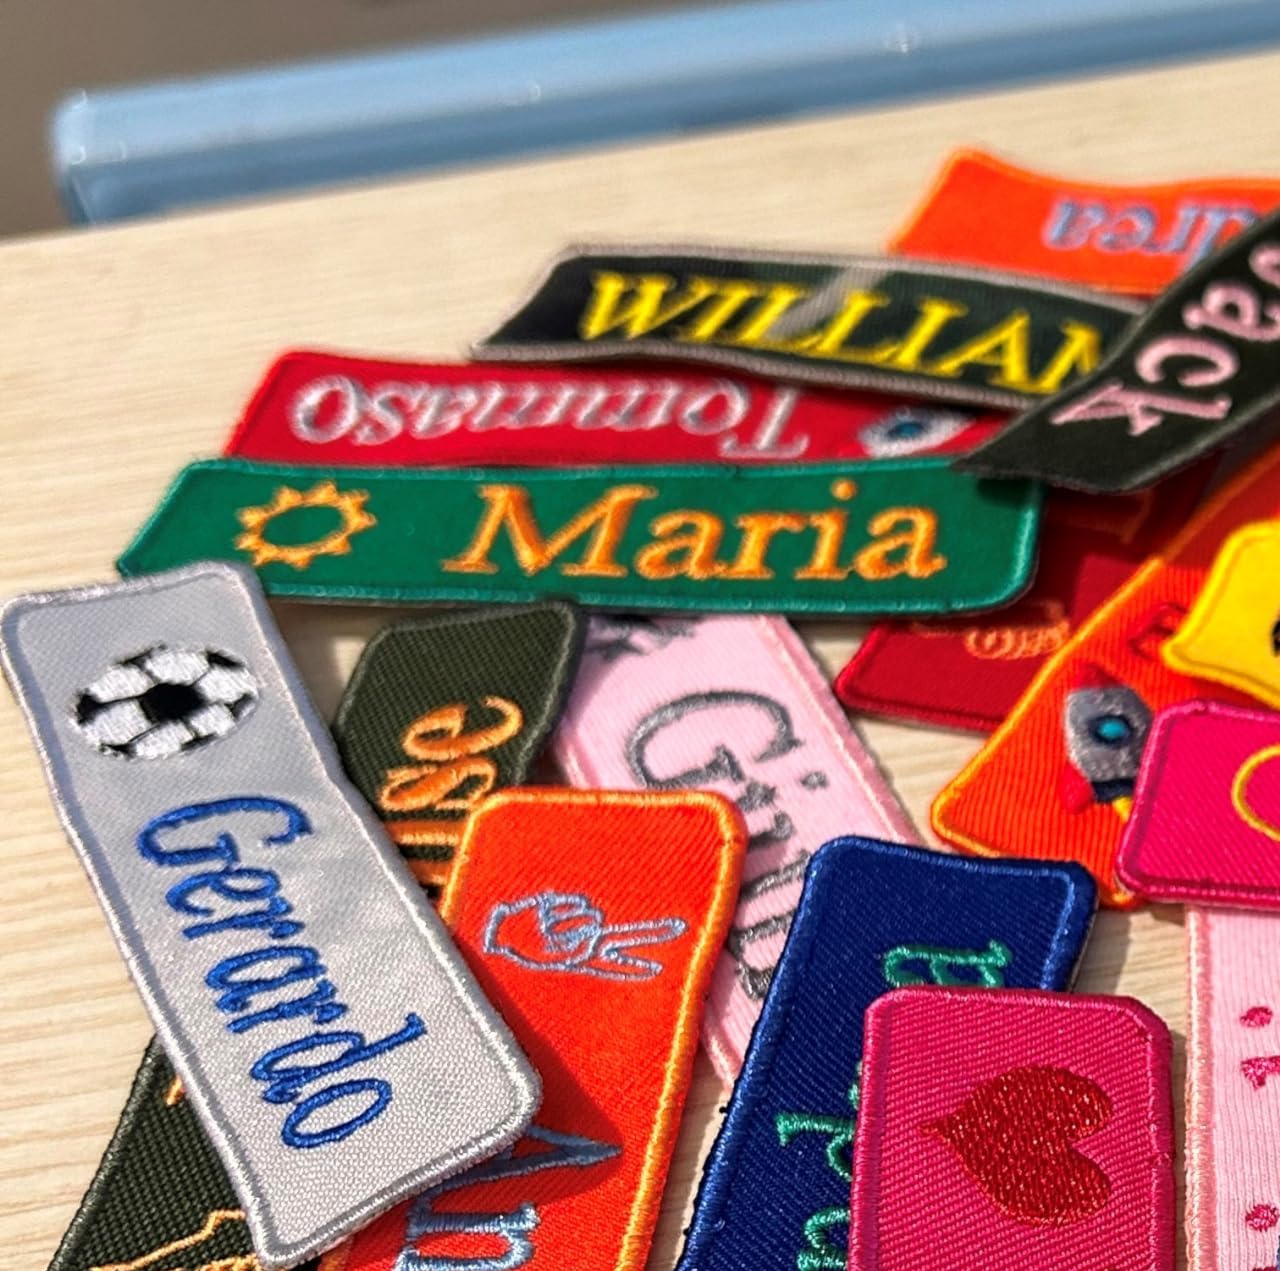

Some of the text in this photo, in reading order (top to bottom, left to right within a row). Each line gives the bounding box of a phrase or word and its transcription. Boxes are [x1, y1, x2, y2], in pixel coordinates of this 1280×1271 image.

[290, 374, 808, 460] Tommaso
[442, 477, 947, 580] Maria
[136, 796, 428, 1150] Gerardo
